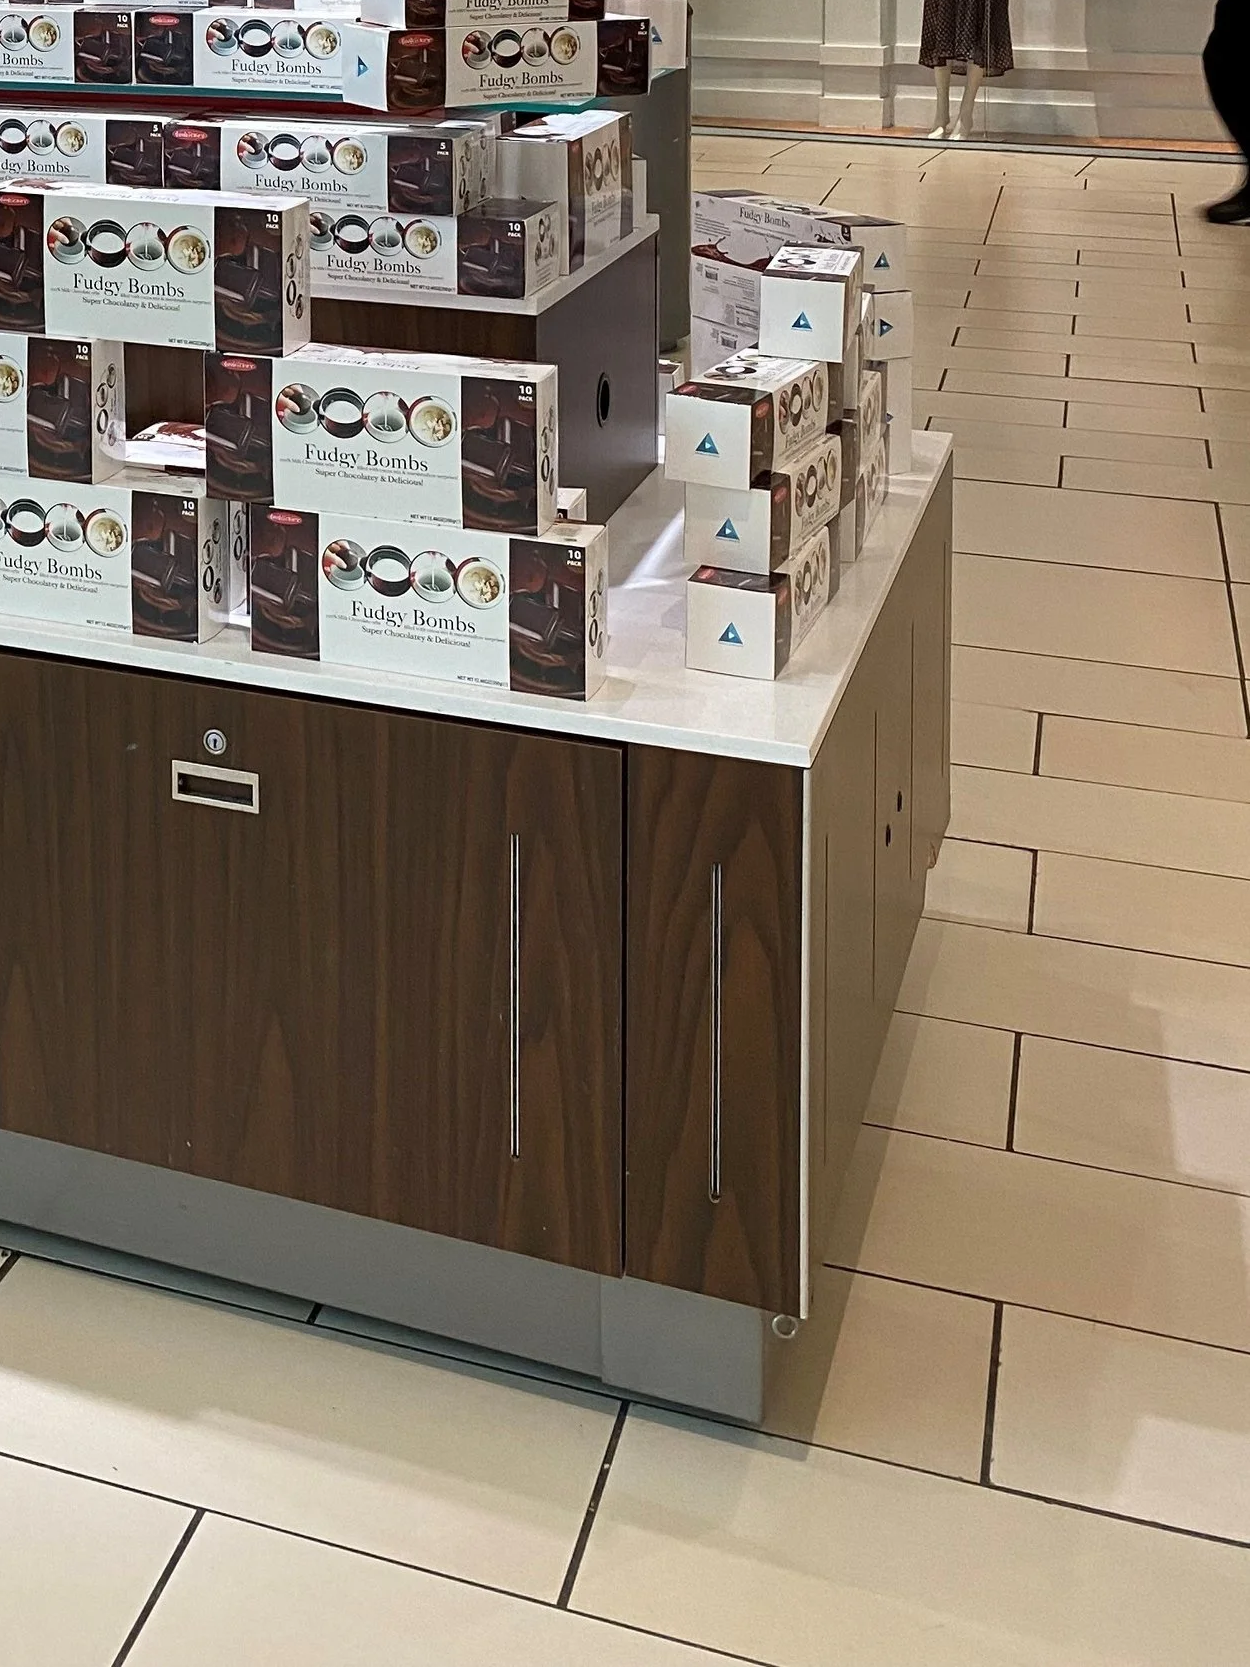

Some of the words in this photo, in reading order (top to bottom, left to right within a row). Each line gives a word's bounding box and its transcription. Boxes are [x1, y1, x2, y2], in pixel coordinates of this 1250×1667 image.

[117, 14, 128, 23] 10
[640, 22, 645, 30] 5
[2, 53, 44, 66] Bombs
[231, 59, 271, 75] Fudgy
[276, 60, 322, 74] Bombs
[479, 74, 519, 89] Fudgy
[521, 71, 564, 85] Bombs
[153, 124, 159, 132] 5
[440, 142, 446, 150] 5
[27, 159, 70, 173] Bombs
[255, 174, 298, 192] Fudgy
[301, 176, 348, 192] Bombs
[266, 213, 279, 223] 10
[739, 207, 763, 224] Fudgy
[764, 212, 791, 229] Bombs
[508, 223, 521, 232] 10
[326, 254, 370, 274] Fudgy
[373, 258, 422, 274] Bombs
[73, 273, 123, 296] Fudgy
[128, 278, 185, 298] Bombs
[82, 297, 101, 305] Super
[76, 345, 88, 354] 10
[519, 385, 532, 395] 10
[305, 443, 360, 468] Fudgy
[366, 450, 428, 471] Bombs
[315, 468, 336, 477] Super
[182, 500, 195, 510] 10
[568, 550, 582, 560] 10
[47, 558, 103, 581] Bombs
[351, 601, 407, 627] Fudgy
[413, 609, 476, 633] Bombs
[361, 625, 382, 635] Super
